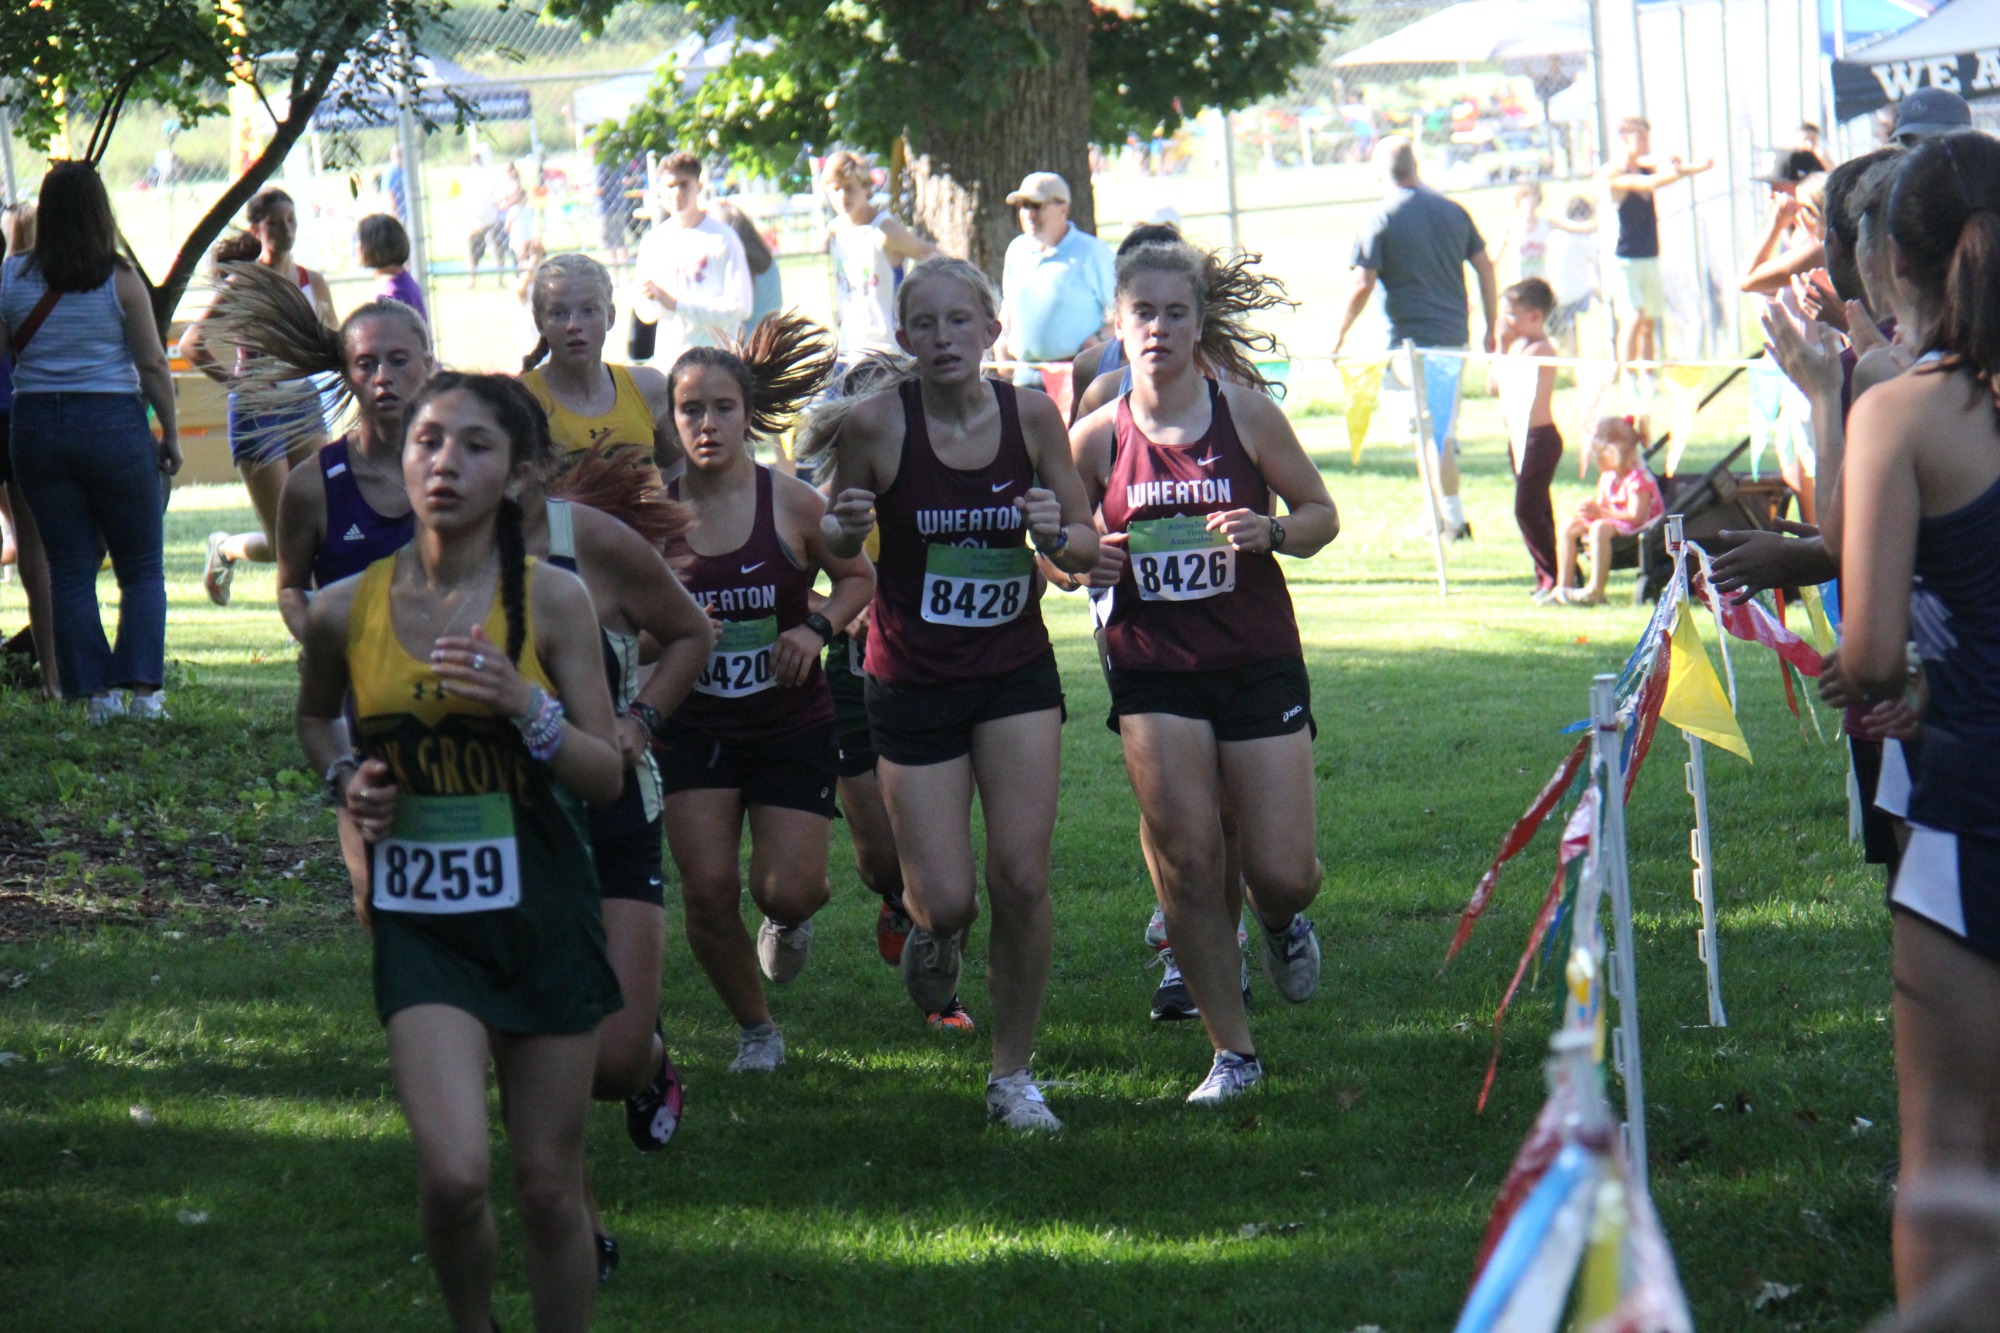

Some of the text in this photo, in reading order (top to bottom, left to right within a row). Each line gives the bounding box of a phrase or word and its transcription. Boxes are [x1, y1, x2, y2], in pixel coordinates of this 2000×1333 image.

[1870, 54, 1961, 102] WE
[1126, 478, 1232, 508] WHEATON
[916, 505, 1022, 535] WHEATON
[1139, 551, 1228, 593] 8426
[690, 584, 776, 612] HEATON
[930, 580, 1021, 619] 8428
[385, 845, 504, 901] 8259
